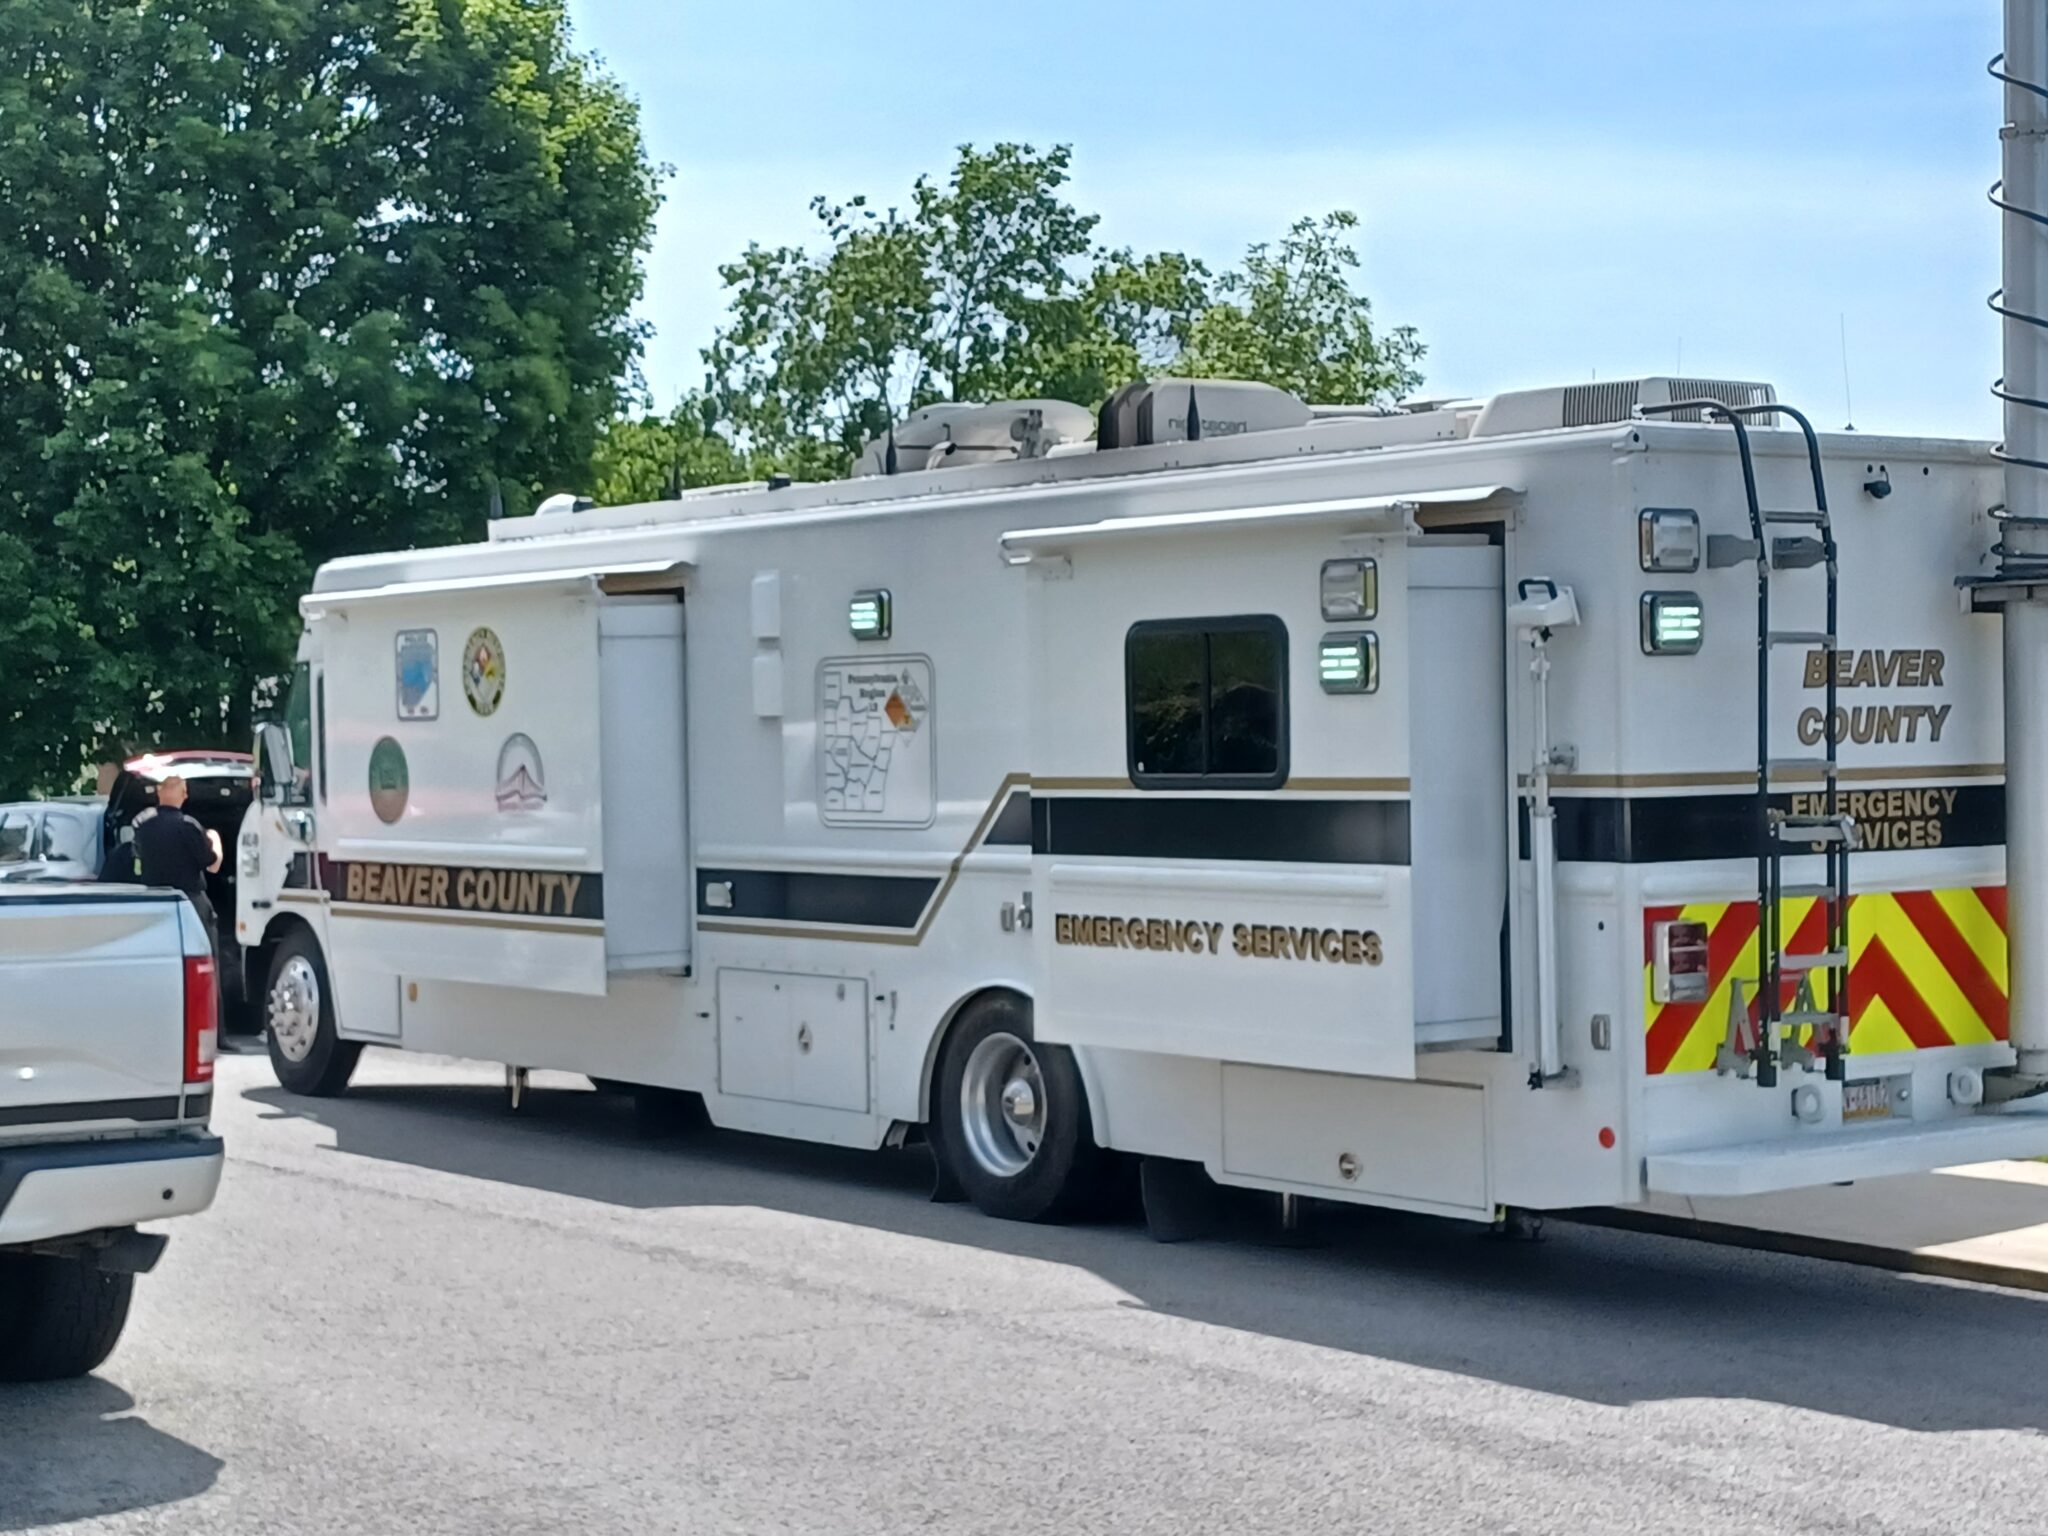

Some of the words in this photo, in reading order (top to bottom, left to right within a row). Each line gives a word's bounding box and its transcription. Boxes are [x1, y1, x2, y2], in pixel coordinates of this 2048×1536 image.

[1803, 649, 1945, 688] BEAVER
[1797, 705, 1952, 746] COUNTY
[1791, 789, 1957, 818] EMERGENCY
[346, 863, 449, 906] BEAVER
[457, 868, 581, 915] COUNTY
[1055, 913, 1224, 954] EMERGENCY
[1232, 923, 1383, 966] SERVICES
